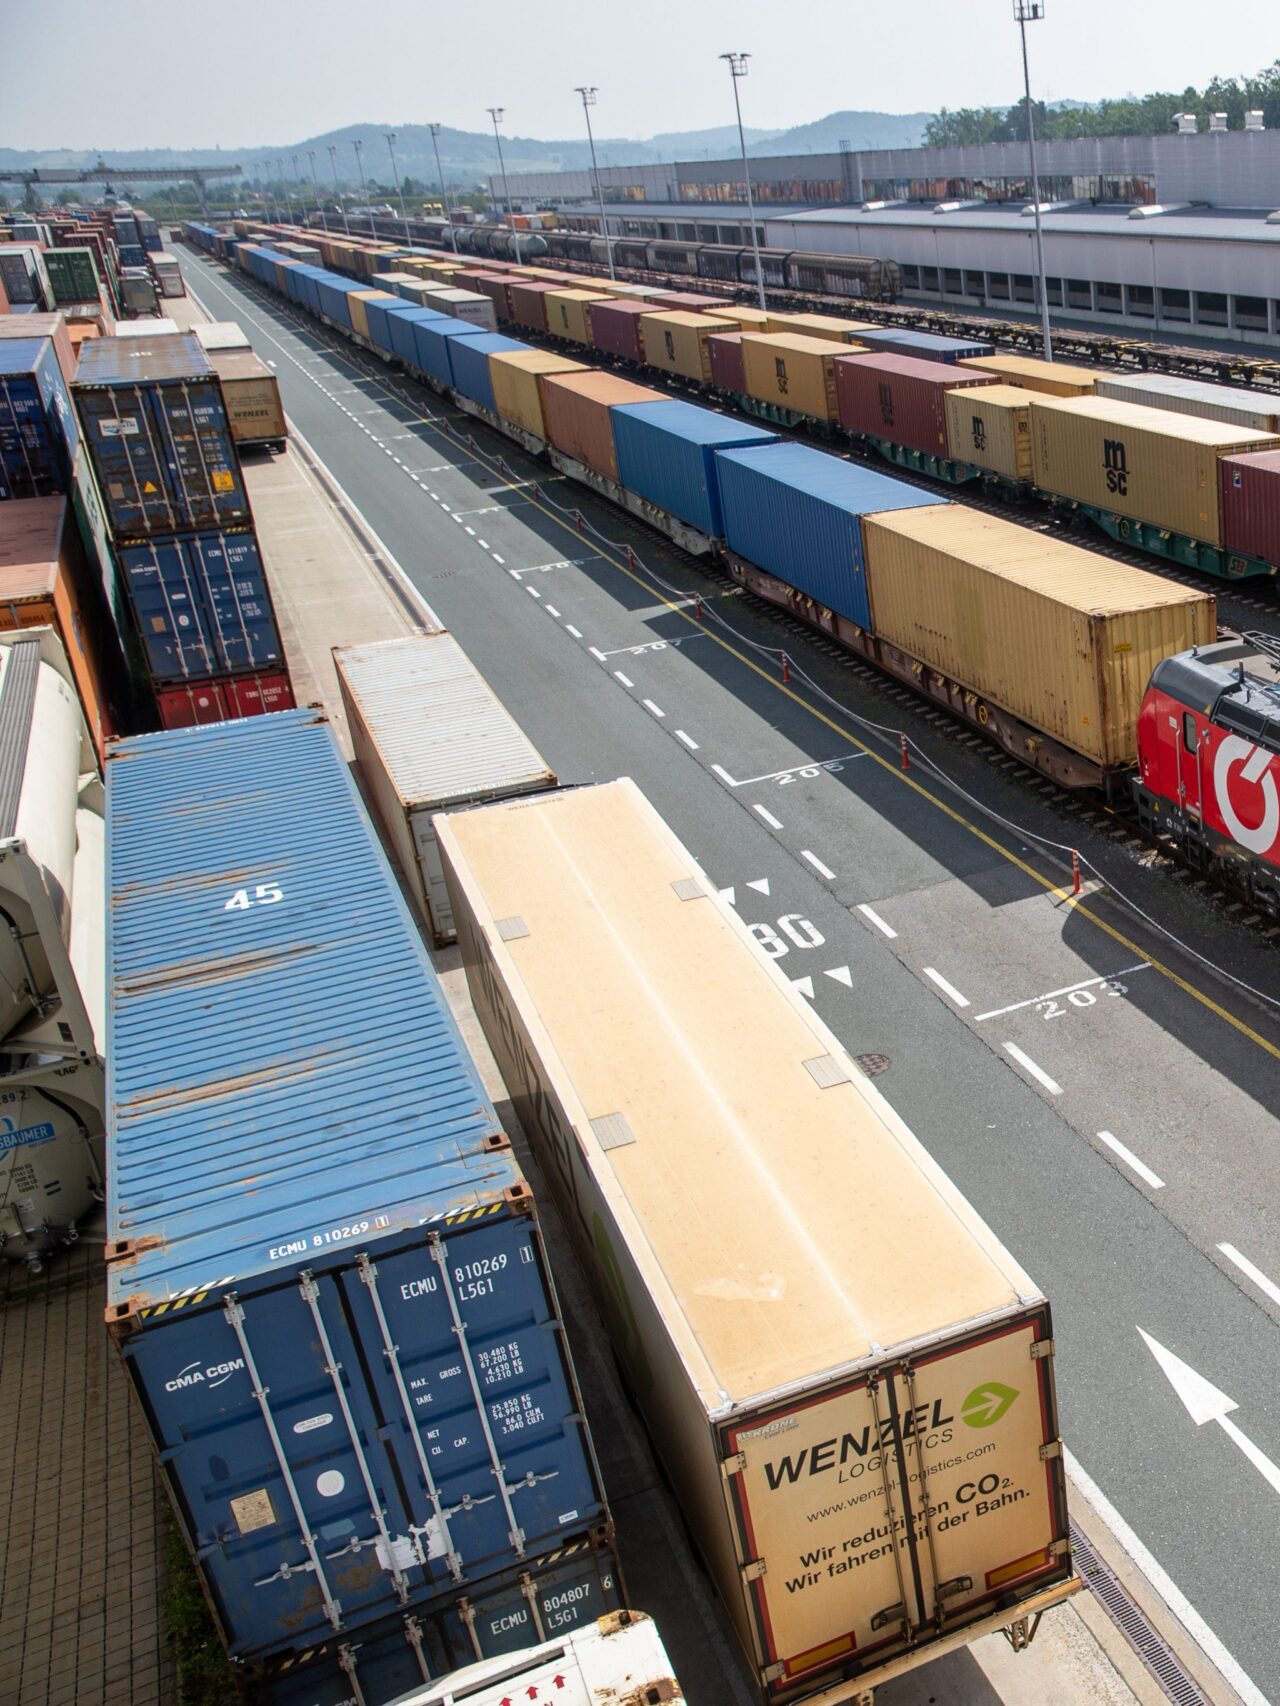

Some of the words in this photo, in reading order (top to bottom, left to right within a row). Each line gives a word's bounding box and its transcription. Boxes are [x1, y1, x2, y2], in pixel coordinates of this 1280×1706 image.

[233, 409, 269, 419] WENZEL
[777, 761, 846, 785] 205
[224, 882, 284, 910] 45
[269, 1239, 307, 1260] ECMU
[313, 1221, 369, 1246] 810269
[400, 1276, 438, 1300] ECMU
[455, 1253, 508, 1283] 810269
[458, 1278, 494, 1301] L5G1
[478, 1346, 506, 1361] 30.480
[508, 1341, 519, 1351] KG
[480, 1353, 508, 1369] 67.200
[510, 1349, 520, 1359] LB
[165, 1372, 206, 1392] CMA
[206, 1358, 245, 1379] CGM
[410, 1377, 429, 1389] MAX.
[439, 1366, 462, 1380] GROSS
[485, 1371, 512, 1385] 10.210
[514, 1365, 524, 1375] LB
[487, 1362, 510, 1376] 4.630
[512, 1358, 523, 1367] KG
[415, 1393, 433, 1406] TARE
[491, 1398, 519, 1413] 25.850
[521, 1393, 531, 1403] KG
[493, 1406, 520, 1421] 56.990
[522, 1401, 532, 1410] LB
[505, 1413, 522, 1426] 86.0
[427, 1429, 440, 1440] NET
[501, 1421, 524, 1435] 3.040
[431, 1446, 443, 1455] CU.
[453, 1437, 470, 1448] CAP.
[764, 1399, 954, 1491] WENZEL
[806, 1441, 997, 1523] www.wenzel-ogistics.com
[785, 1572, 822, 1594] Wir
[828, 1543, 894, 1577] fahren
[937, 1513, 970, 1533] der
[975, 1488, 1030, 1515] Bahn.
[800, 1547, 836, 1569] Wir
[490, 1610, 528, 1636] ECMU
[543, 1583, 590, 1613] 804807
[547, 1606, 578, 1630] L5G1
